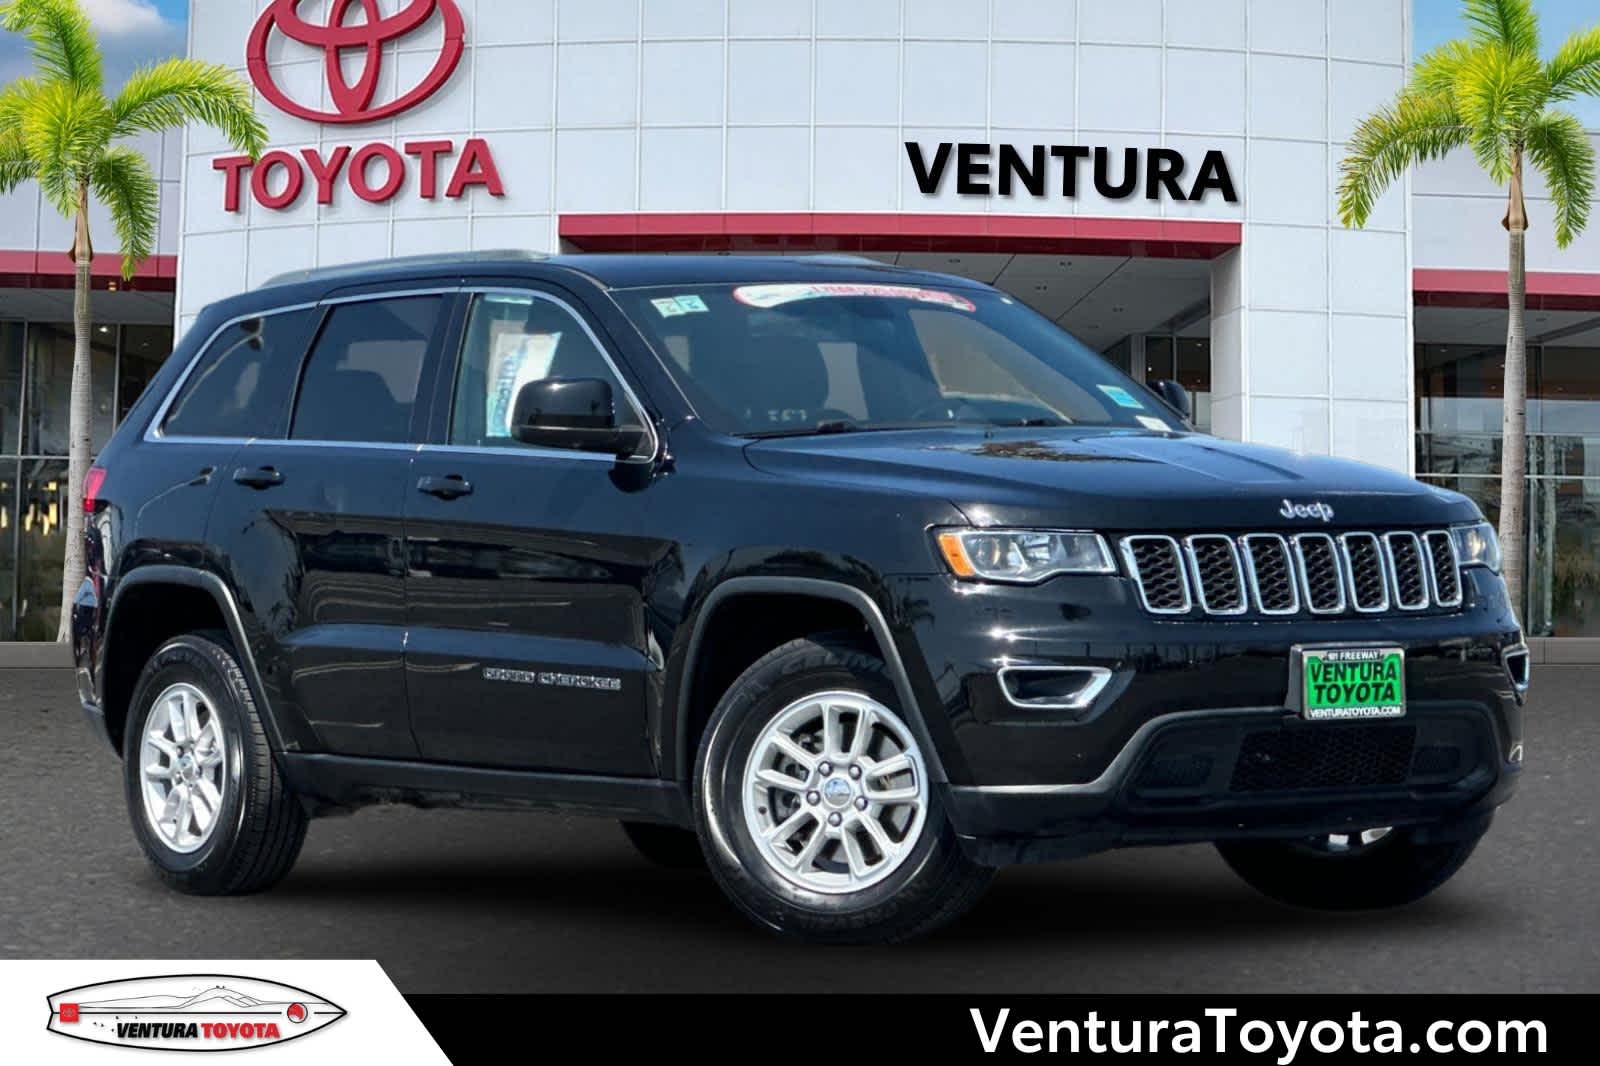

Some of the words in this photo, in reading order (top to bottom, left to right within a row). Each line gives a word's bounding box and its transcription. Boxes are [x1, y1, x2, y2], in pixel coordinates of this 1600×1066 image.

[212, 138, 505, 212] TOYOTA
[904, 141, 1238, 203] VENTURA
[1280, 499, 1335, 522] Jeep
[1340, 650, 1379, 661] FREEWAY
[1311, 661, 1397, 683] VENTURA
[1314, 682, 1396, 704] TOYOTA
[1310, 706, 1401, 719] VENTURATOYOTA.COM
